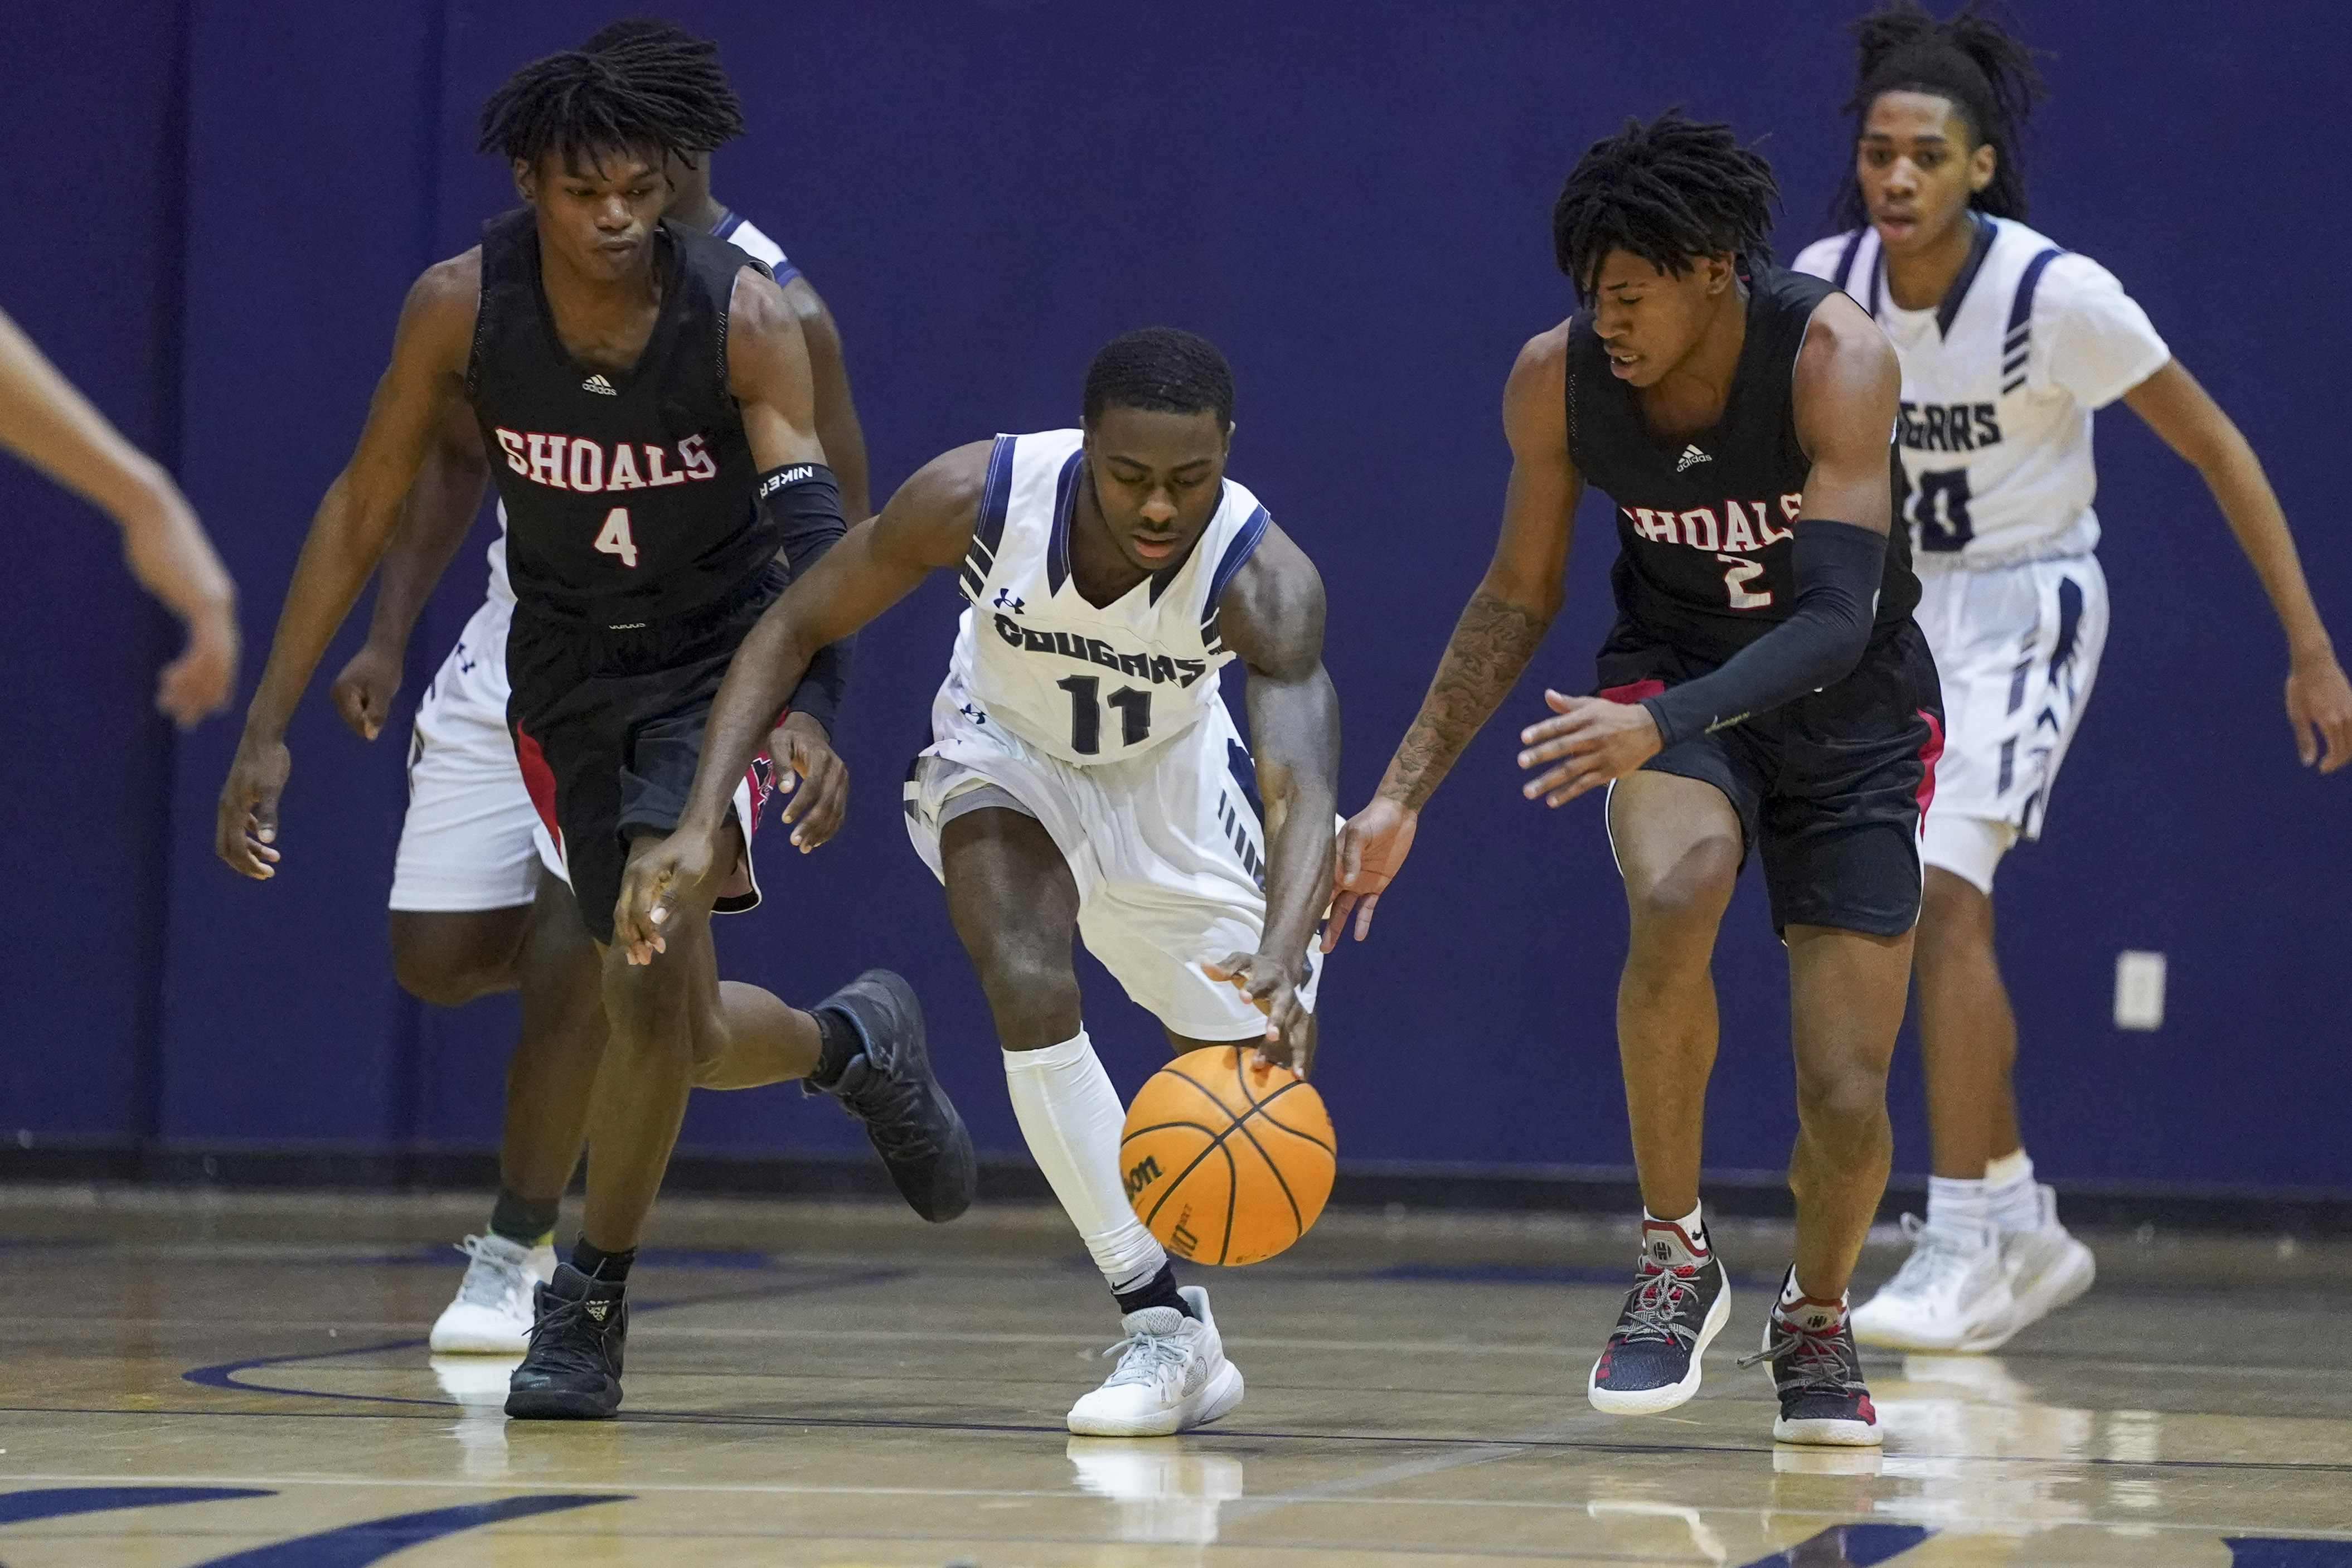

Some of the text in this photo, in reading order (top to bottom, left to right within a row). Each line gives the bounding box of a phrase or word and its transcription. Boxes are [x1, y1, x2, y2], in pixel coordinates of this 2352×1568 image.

[581, 383, 617, 396] adidas
[1897, 404, 2002, 450] GARS
[494, 426, 717, 493] SHOALS
[1676, 454, 1713, 473] adidas
[593, 506, 638, 567] 4
[1899, 467, 1974, 552] 0
[1715, 553, 1774, 610] 2
[992, 613, 1206, 688] COUGARS
[1056, 674, 1152, 755] 11
